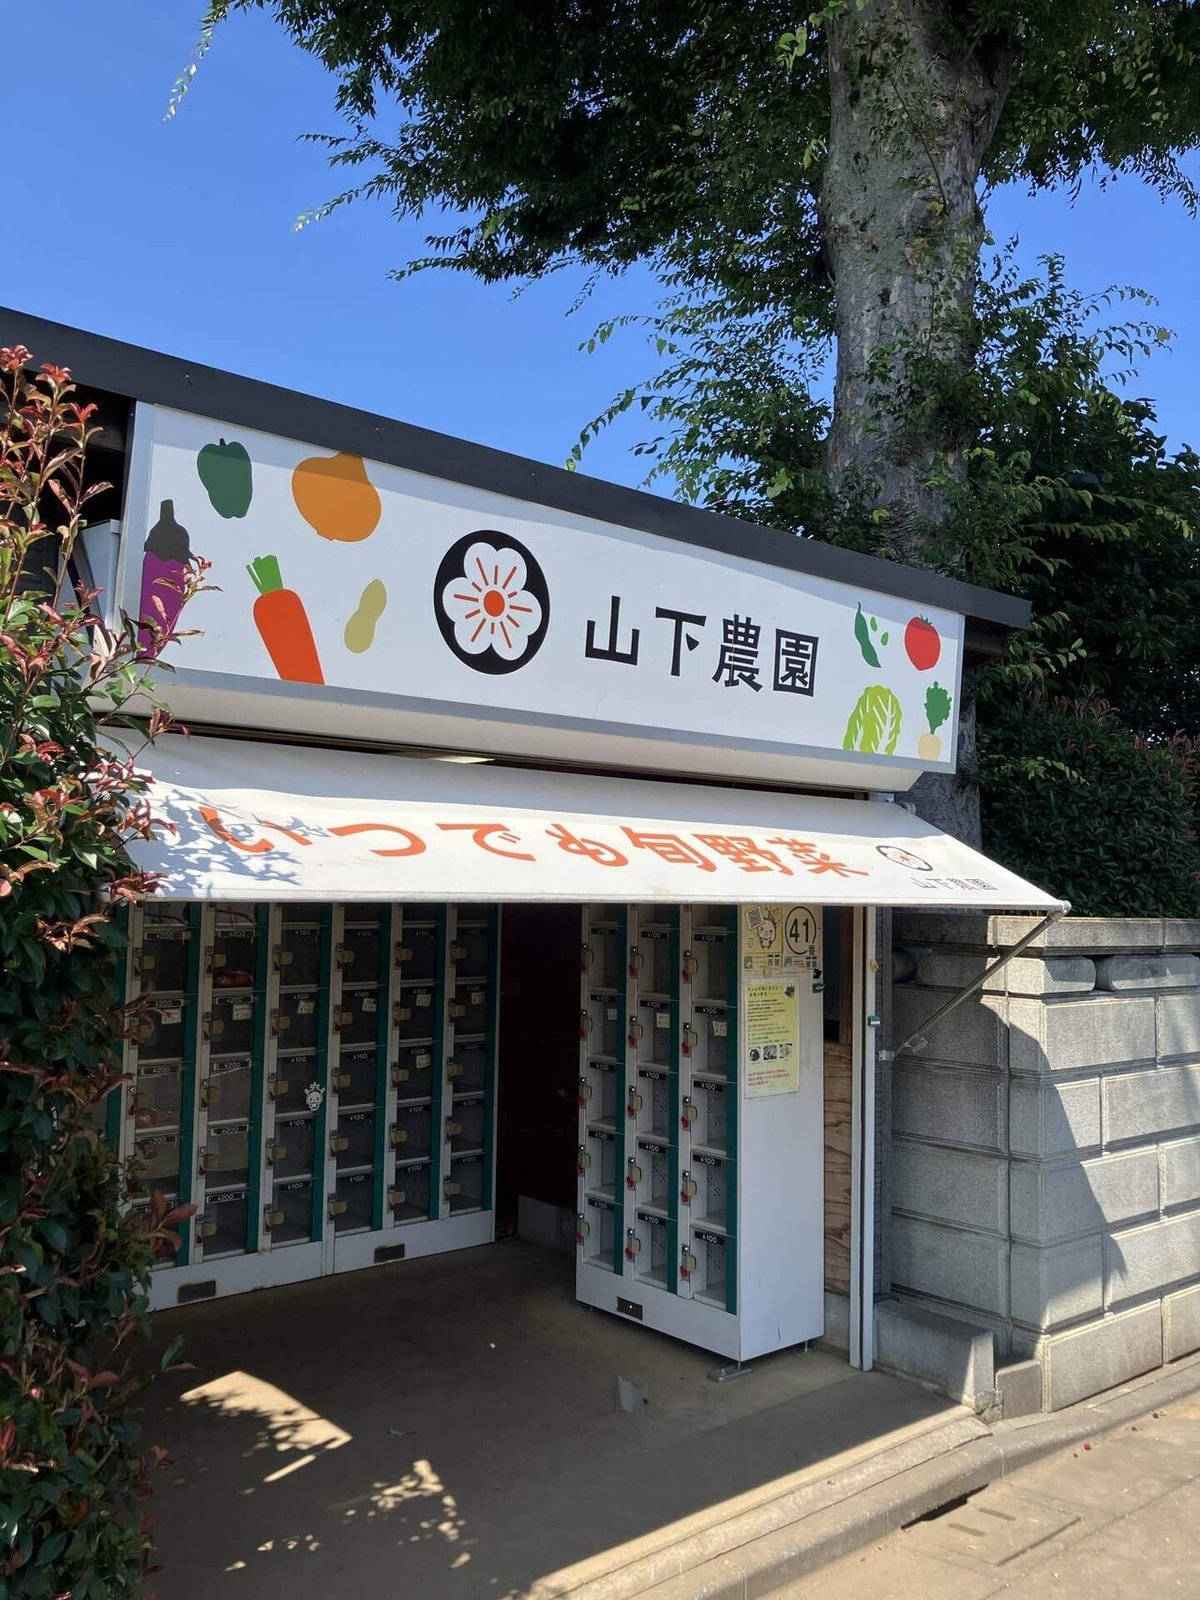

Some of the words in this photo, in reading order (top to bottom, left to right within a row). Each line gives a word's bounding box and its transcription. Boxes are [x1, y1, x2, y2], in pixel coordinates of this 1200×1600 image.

[585, 595, 819, 697] 山下農園
[199, 806, 869, 877] いつでも旬野菜
[789, 918, 810, 943] 41
